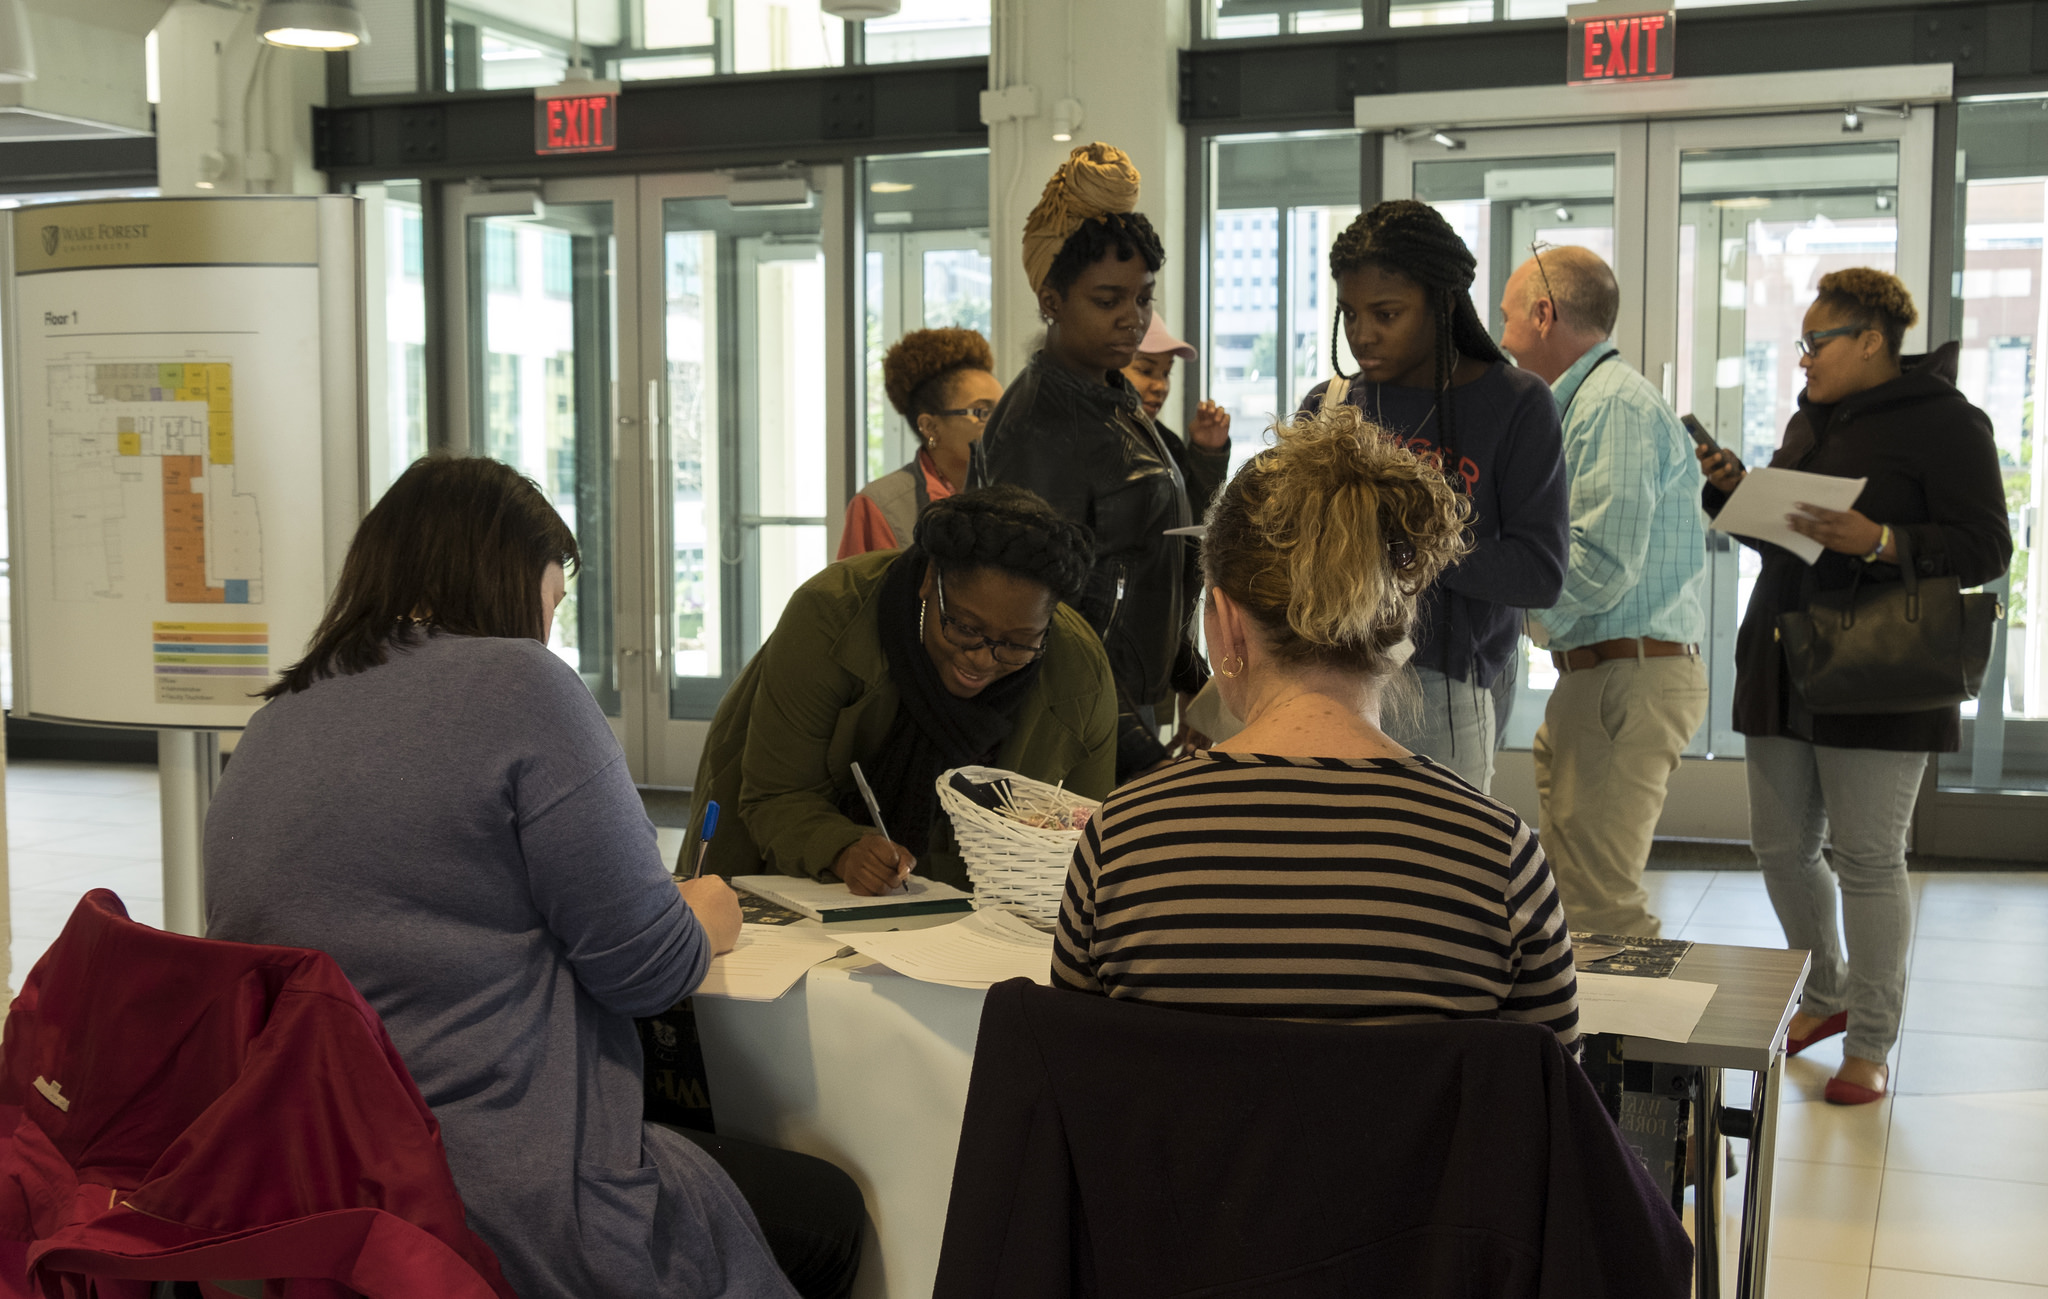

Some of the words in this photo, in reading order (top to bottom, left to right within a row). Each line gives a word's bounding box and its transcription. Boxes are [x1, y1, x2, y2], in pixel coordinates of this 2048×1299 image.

[1583, 16, 1665, 78] EXIT
[547, 97, 607, 147] EXIT
[98, 224, 149, 239] FOREST
[71, 310, 78, 325] 1
